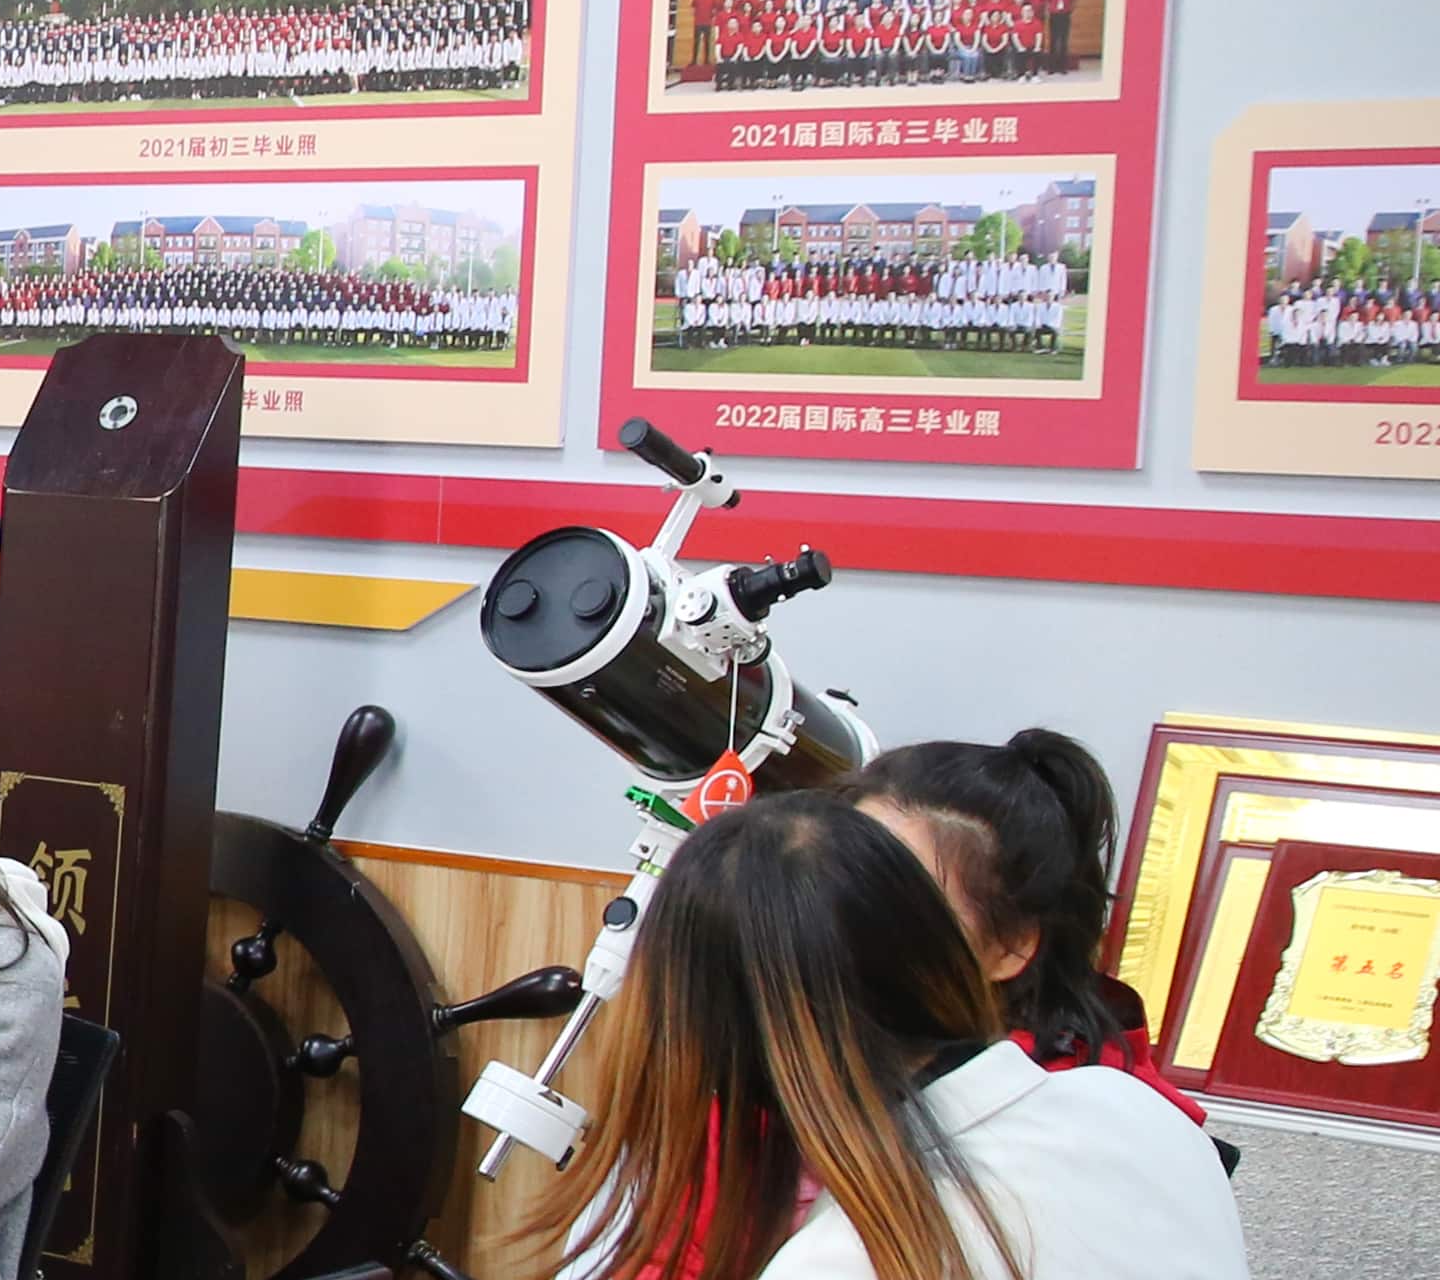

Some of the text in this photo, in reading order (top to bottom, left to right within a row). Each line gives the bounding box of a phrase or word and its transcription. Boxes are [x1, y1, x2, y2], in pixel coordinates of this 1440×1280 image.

[138, 133, 317, 161] 2021届初三毕业照
[730, 116, 1019, 149] 2021届国际高三毕业照
[715, 403, 1000, 438] 2022届国际高三毕业照
